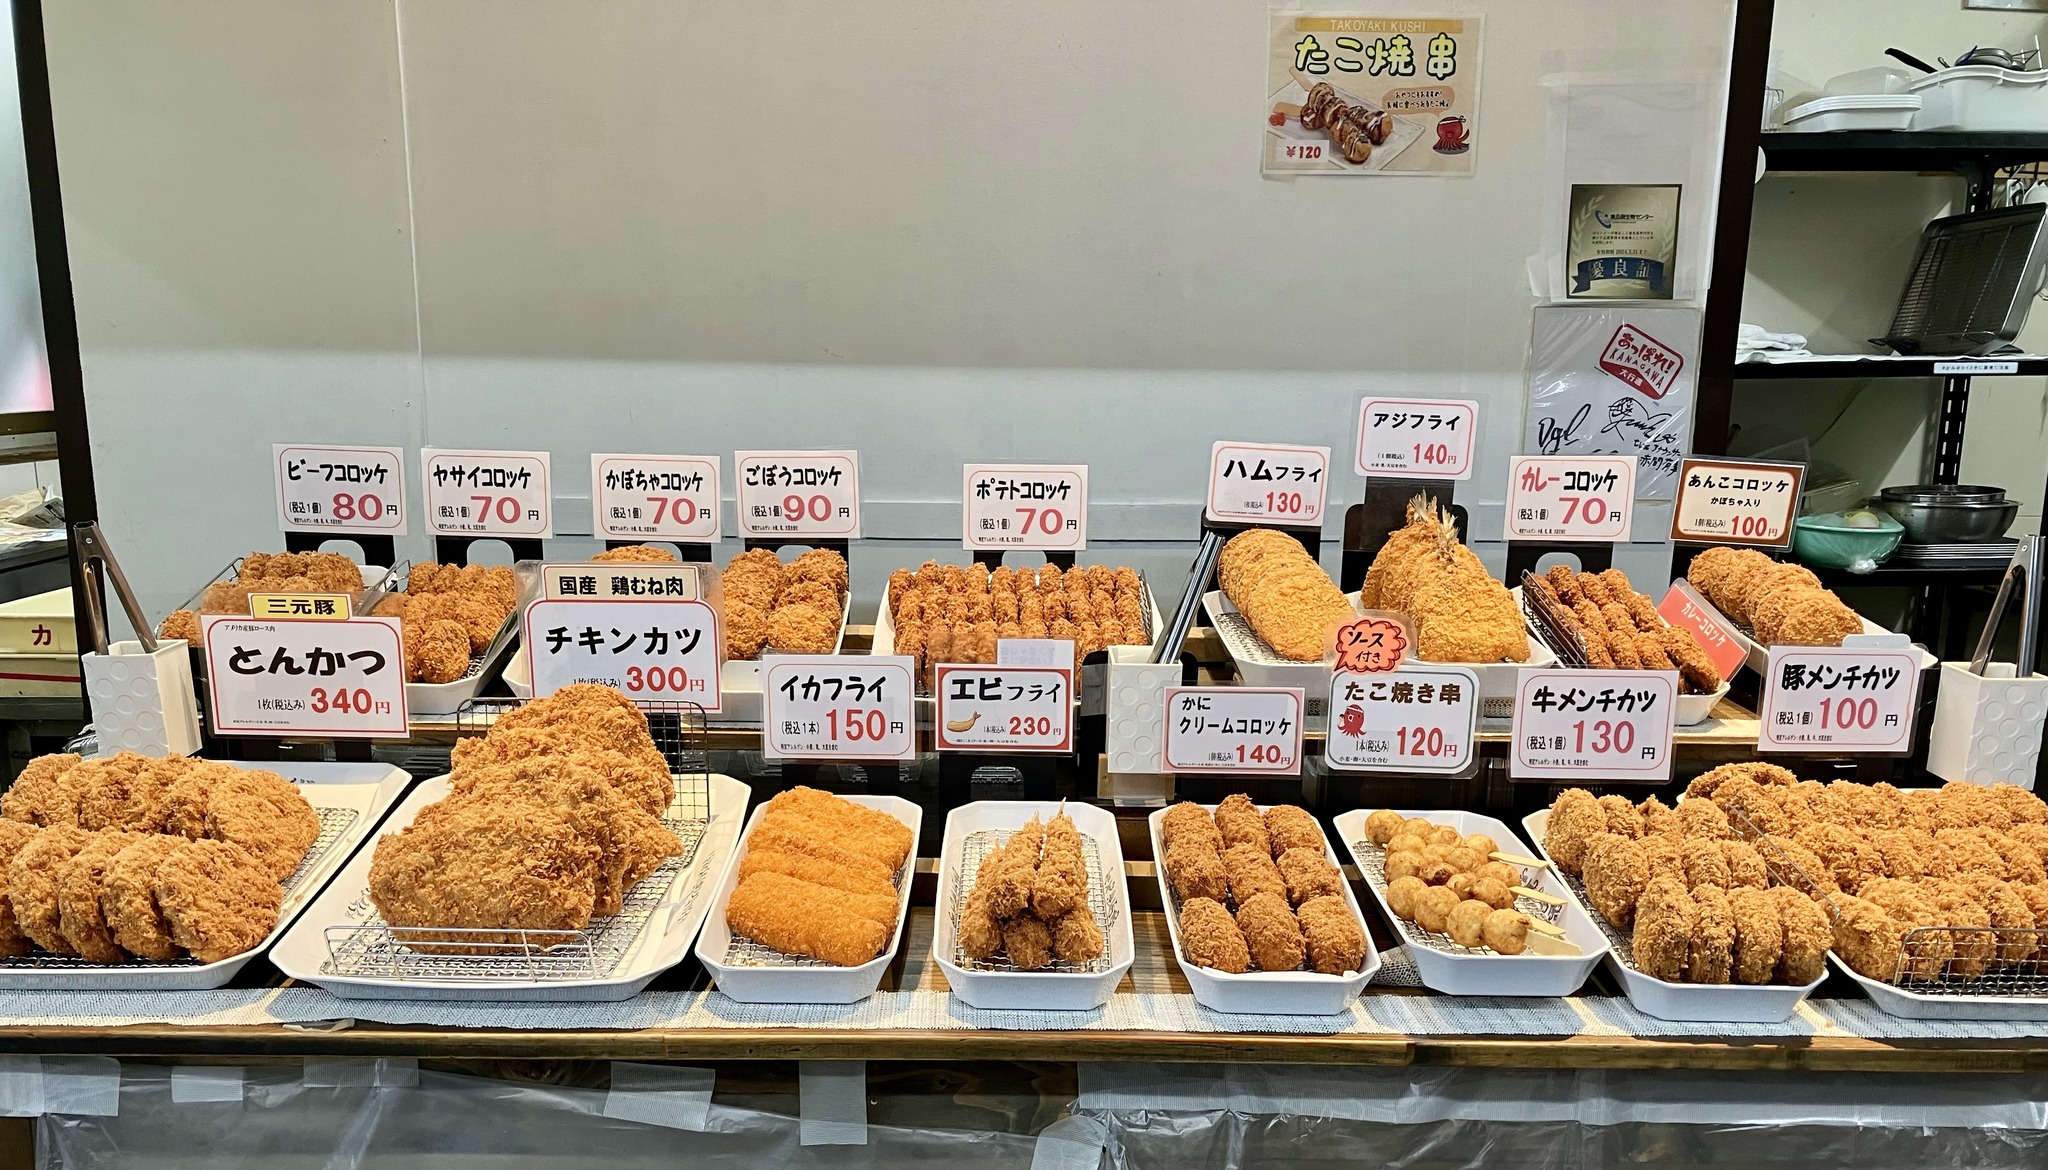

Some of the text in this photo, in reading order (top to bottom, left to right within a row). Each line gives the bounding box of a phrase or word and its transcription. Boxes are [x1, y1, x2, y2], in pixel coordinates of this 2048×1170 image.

[1330, 20, 1426, 33] TAKOYAKI KUSHI
[1427, 32, 1456, 80] 串
[1286, 146, 1321, 158] ¥120
[1618, 332, 1676, 374] あっぱれ!
[1609, 348, 1665, 389] KANAGAWA
[1373, 413, 1461, 431] アジフライ
[288, 459, 388, 484] ビーフコロッケ
[433, 464, 531, 489] ヤサイコロッケ
[606, 468, 703, 492] かぼちゃコロッケ
[746, 464, 842, 487] ごぼうコロッケ
[1223, 459, 1322, 482] ハムフライ
[1522, 466, 1618, 492] カレーコロッケ
[976, 478, 1071, 500] ポテトコロッケ
[1688, 474, 1789, 493] あんこコロッケ
[1710, 497, 1760, 507] かぼちゃ入り
[559, 576, 684, 596] 国産 鶏むね肉
[268, 599, 336, 615] 三元豚
[1681, 602, 1727, 647] カレーコロッケ
[546, 626, 701, 655] チキンカツ
[1348, 631, 1384, 648] ソース
[229, 646, 386, 676] とんかつ
[1355, 651, 1381, 663] 付き
[1781, 663, 1901, 690] 豚メンチカツ
[780, 675, 886, 702] イカフライ
[950, 677, 1061, 703] エビフライ
[1344, 681, 1461, 705] たこ焼き串
[1532, 686, 1657, 713] 牛メンチカツ
[257, 698, 305, 711] 1枚(税込み)
[1182, 697, 1211, 711] かに
[1179, 716, 1291, 736] クリームコロッケ
